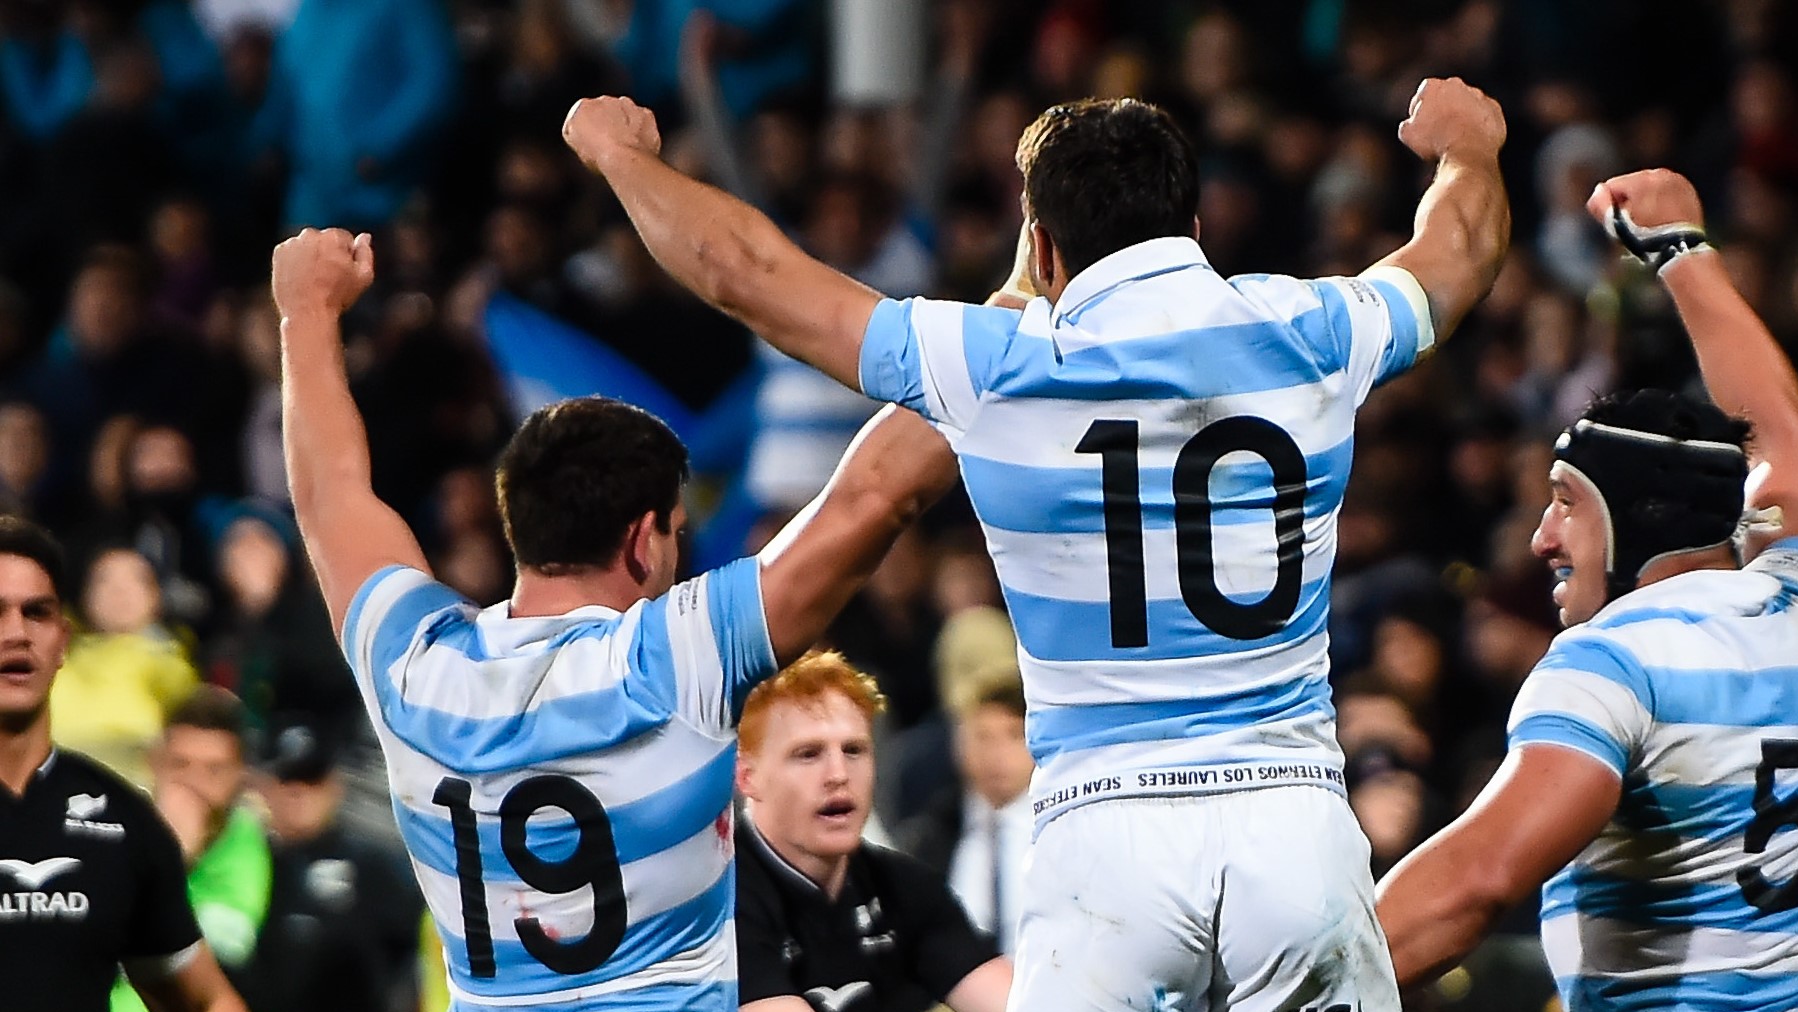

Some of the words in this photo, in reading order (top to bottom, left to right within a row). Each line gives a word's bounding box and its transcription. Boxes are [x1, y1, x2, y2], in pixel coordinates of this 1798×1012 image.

[1075, 416, 1307, 648] 10
[1138, 770, 1218, 787] LAURELES
[1223, 767, 1253, 783] LOS
[1082, 776, 1122, 796] SEAN
[432, 775, 627, 978] 19
[0, 891, 89, 914] LTRAD
